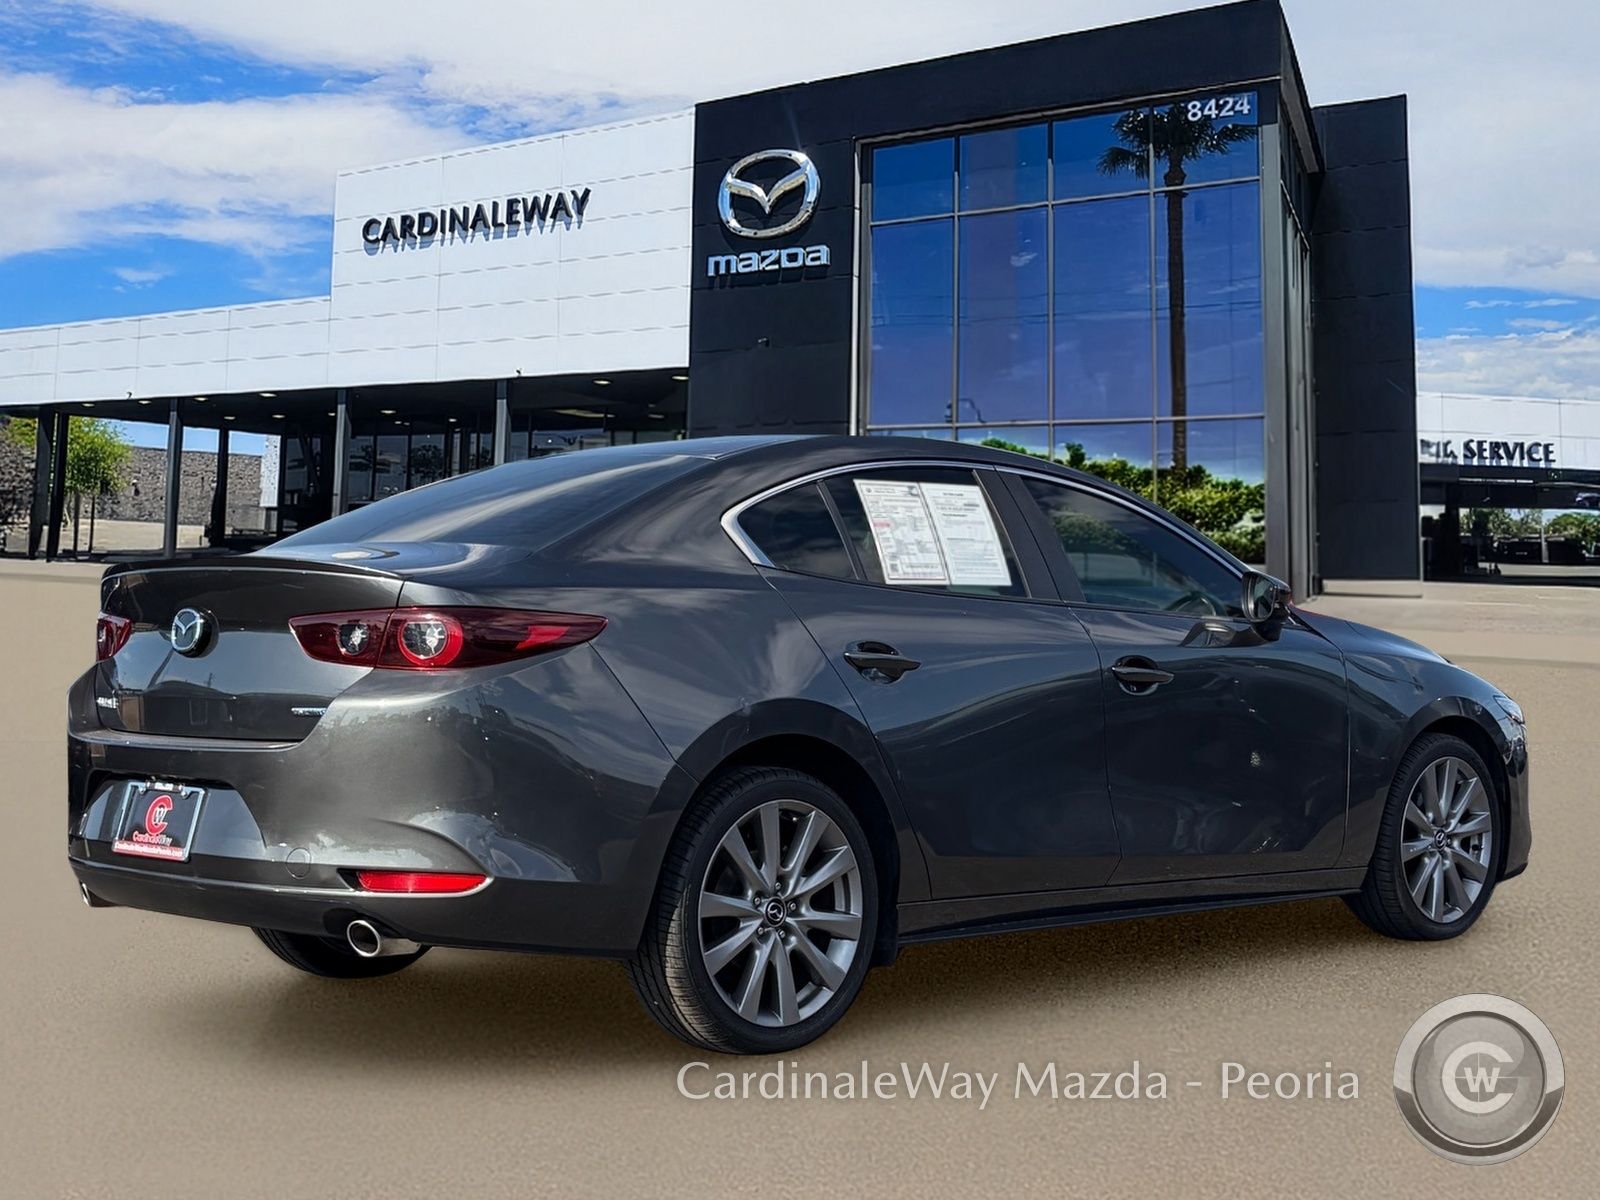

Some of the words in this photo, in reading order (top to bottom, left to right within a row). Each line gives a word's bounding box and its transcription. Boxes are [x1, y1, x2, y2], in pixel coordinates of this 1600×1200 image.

[1187, 95, 1250, 121] 8424
[362, 187, 592, 244] CARDINALEWAY
[707, 244, 830, 277] mazda
[1463, 439, 1556, 463] SERVICE
